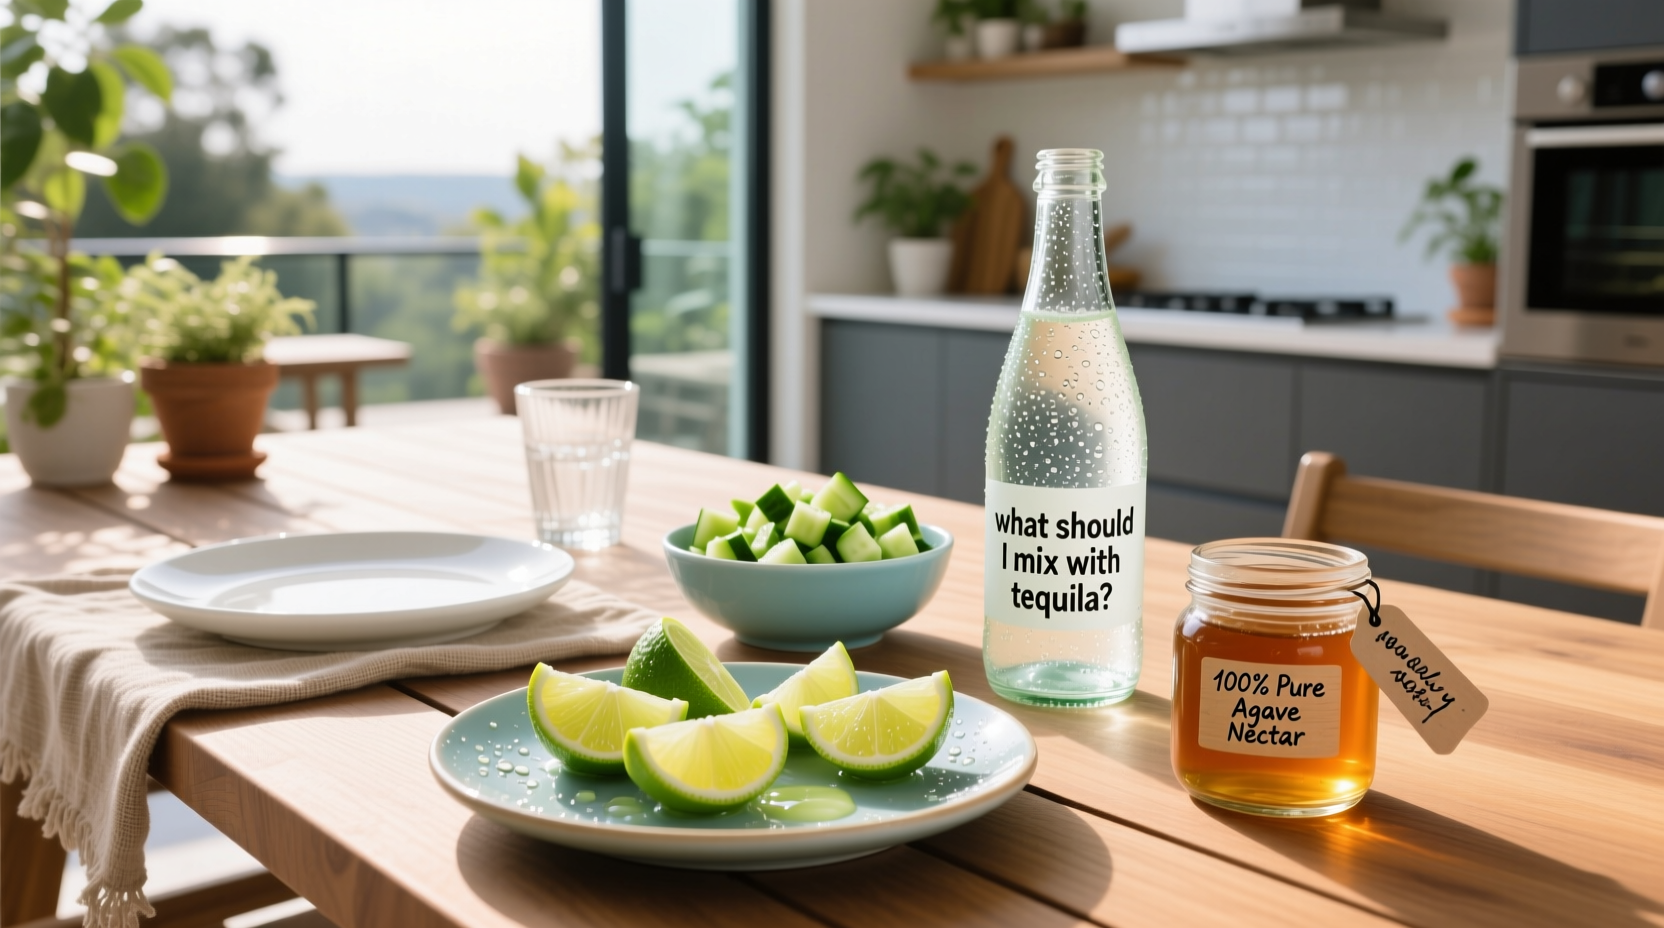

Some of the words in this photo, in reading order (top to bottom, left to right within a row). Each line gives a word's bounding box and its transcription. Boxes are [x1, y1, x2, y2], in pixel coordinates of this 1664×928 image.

[995, 507, 1049, 538] what
[1056, 506, 1134, 539] should
[1002, 542, 1007, 570] I
[1014, 546, 1059, 575] mix
[1066, 545, 1120, 575] with
[1011, 582, 1113, 619] tequila?
[1213, 669, 1269, 695] 100%
[1276, 674, 1325, 697] Pure
[1231, 697, 1301, 728] Agave
[1227, 721, 1305, 746] Nectar
